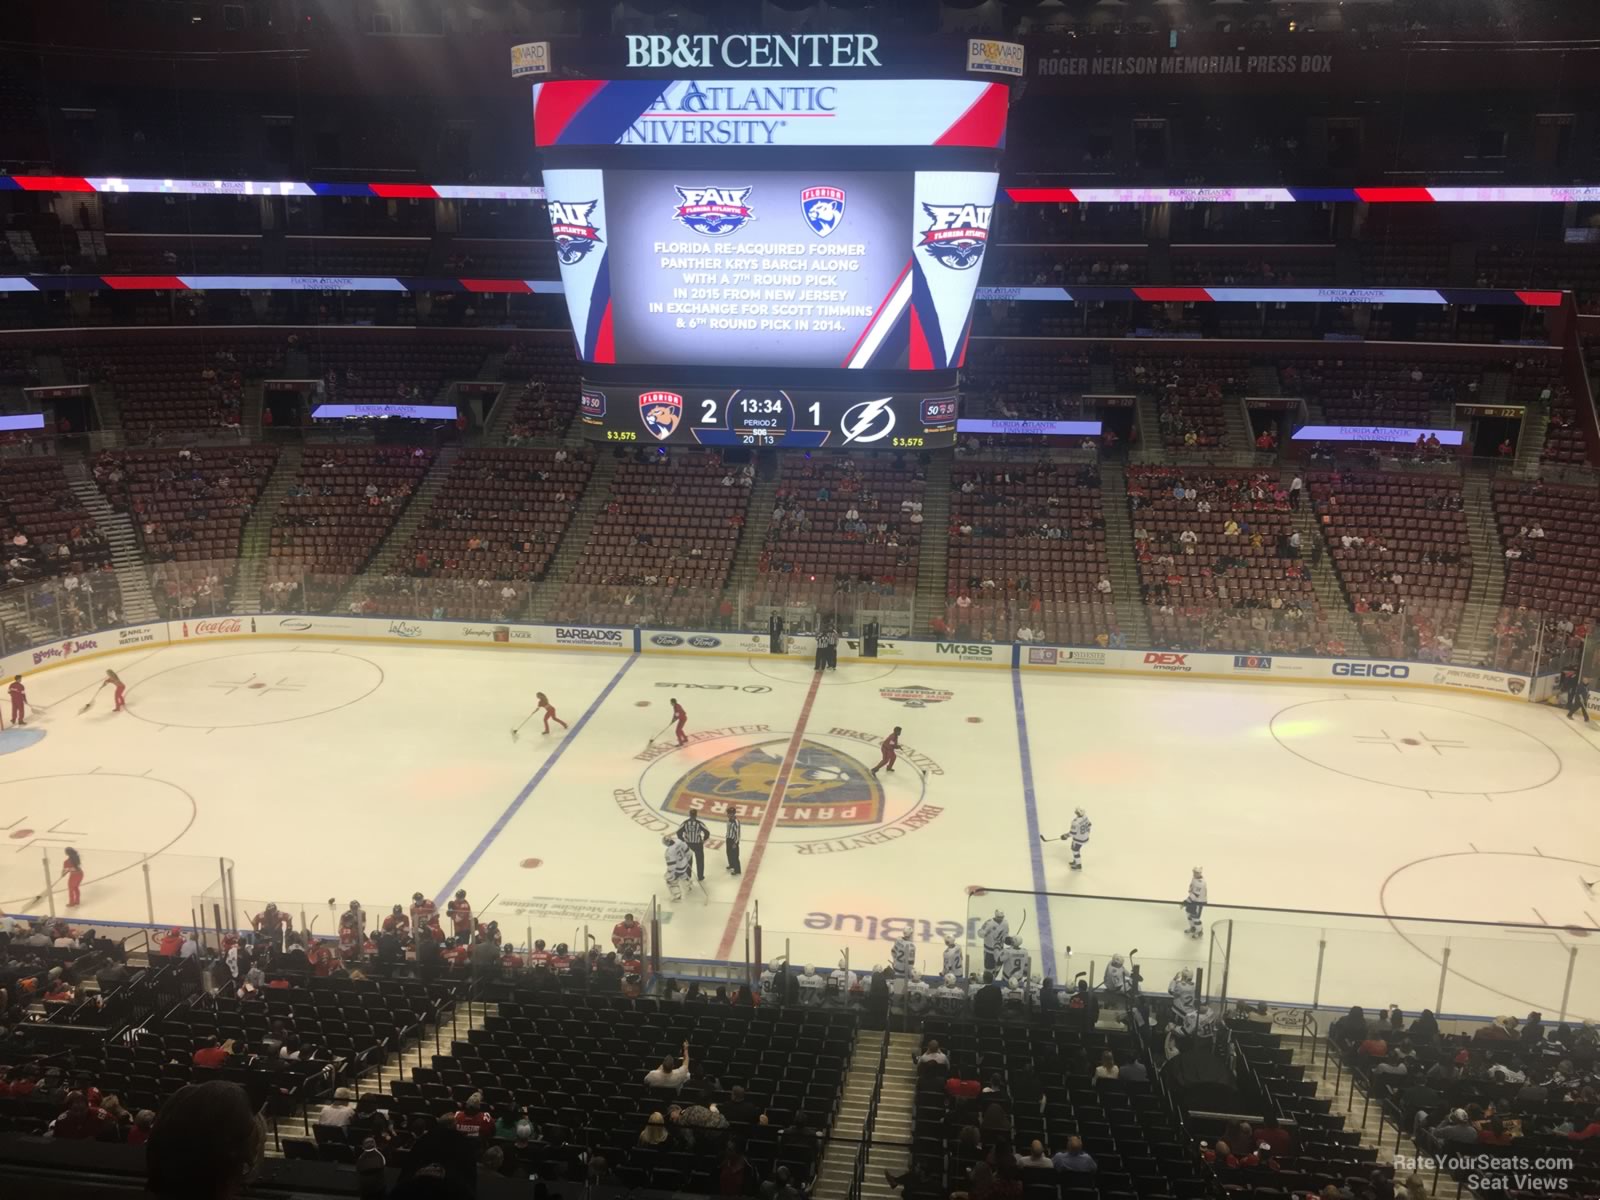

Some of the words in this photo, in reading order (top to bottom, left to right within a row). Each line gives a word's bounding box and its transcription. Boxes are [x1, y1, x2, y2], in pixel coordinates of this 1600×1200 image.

[626, 34, 719, 68] BB&T
[721, 34, 882, 68] CENTER
[1038, 58, 1088, 76] ROGER
[1092, 57, 1157, 75] NEILSON
[1161, 56, 1242, 75] MEMORIAL
[1247, 56, 1297, 74] PRESS
[1301, 55, 1332, 73] BOX
[676, 80, 837, 113] ATLANTIC
[684, 189, 743, 207] FAU
[805, 188, 842, 199] FLORIDA
[654, 243, 711, 255] FLORIDA
[714, 244, 805, 256] RE-ACQUIRED
[809, 245, 866, 257] FORMER
[661, 258, 723, 270] PANTHER
[726, 259, 758, 271] KRYS
[761, 259, 808, 271] BARCH
[811, 260, 860, 272] ALONG
[683, 274, 717, 286] WITH
[720, 274, 731, 286] A
[754, 274, 802, 286] ROUND
[806, 274, 838, 286] PICK
[674, 288, 689, 300] IN
[692, 289, 721, 301] 2015
[723, 289, 763, 301] FROM
[765, 289, 797, 301] NEW
[799, 290, 848, 302] JERSEY
[649, 303, 664, 315] IN
[667, 304, 742, 316] EXCHANGE
[744, 304, 769, 316] FOR
[771, 304, 813, 316] SCOTT
[815, 305, 873, 317] TIMMINS
[676, 318, 688, 330] &
[710, 319, 757, 331] ROUND
[761, 319, 793, 331] PICK
[795, 319, 809, 331] IN
[812, 320, 846, 332] 2014.
[643, 393, 679, 404] FLORIDA
[701, 399, 717, 423] 2
[740, 399, 782, 414] 13:34
[927, 405, 938, 415] 50
[1500, 408, 1516, 418] 122
[808, 402, 820, 426] 1
[743, 419, 770, 427] PERIOD
[771, 417, 778, 428] 2
[753, 428, 768, 436] SOG
[743, 435, 754, 444] 20
[763, 435, 774, 445] 13
[119, 637, 139, 646] WATCH
[141, 634, 154, 643] LIVE
[556, 628, 622, 641] BARBADOS
[656, 634, 681, 647] Ford
[692, 636, 717, 648] Ford
[936, 643, 993, 656] MOSS
[1143, 653, 1187, 665] DEX
[1153, 663, 1191, 672] imaging
[1331, 663, 1410, 679] GEICO
[655, 681, 739, 695] LEXUS
[690, 797, 857, 820] PANTHERS
[804, 911, 981, 947] jetBlue
